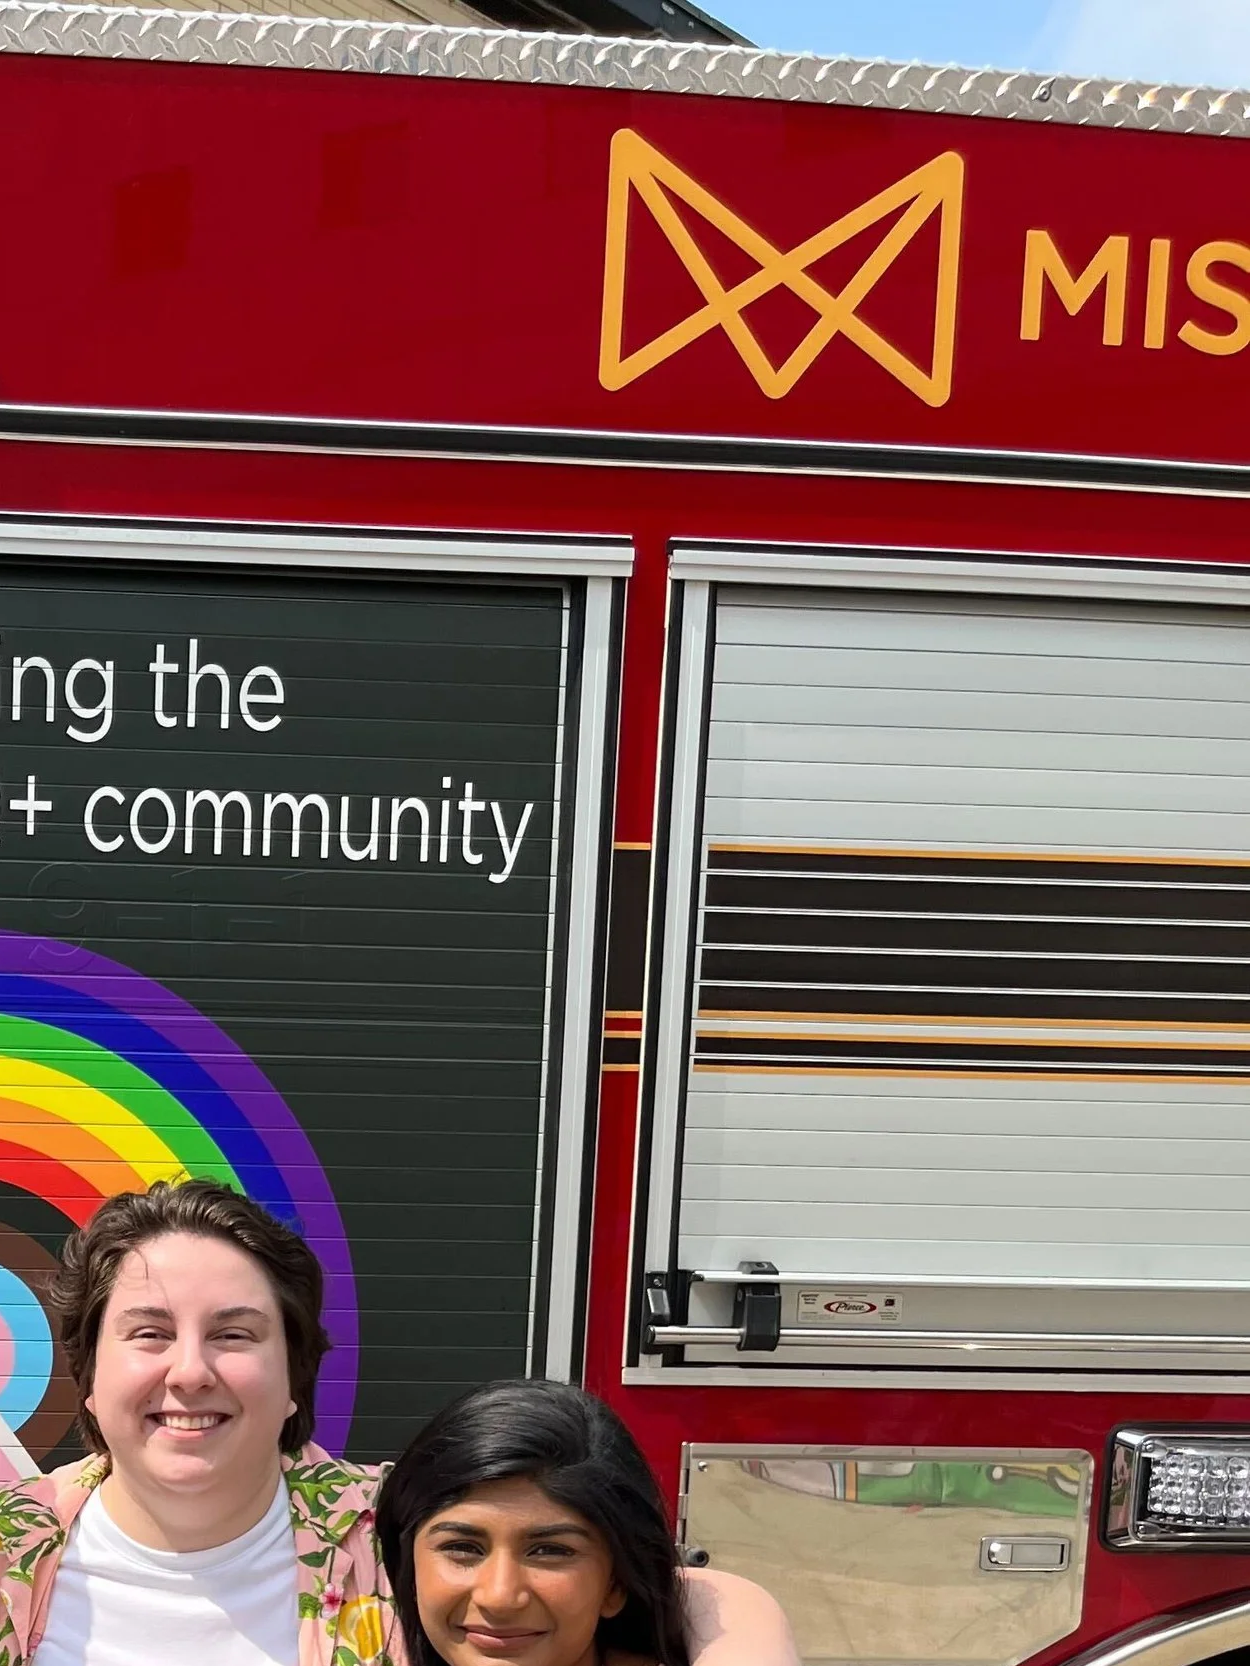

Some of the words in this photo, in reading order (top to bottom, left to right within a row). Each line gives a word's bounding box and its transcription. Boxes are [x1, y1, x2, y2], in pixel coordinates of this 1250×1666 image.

[1019, 229, 1250, 356] MIS
[149, 638, 285, 732] the
[84, 776, 534, 884] community
